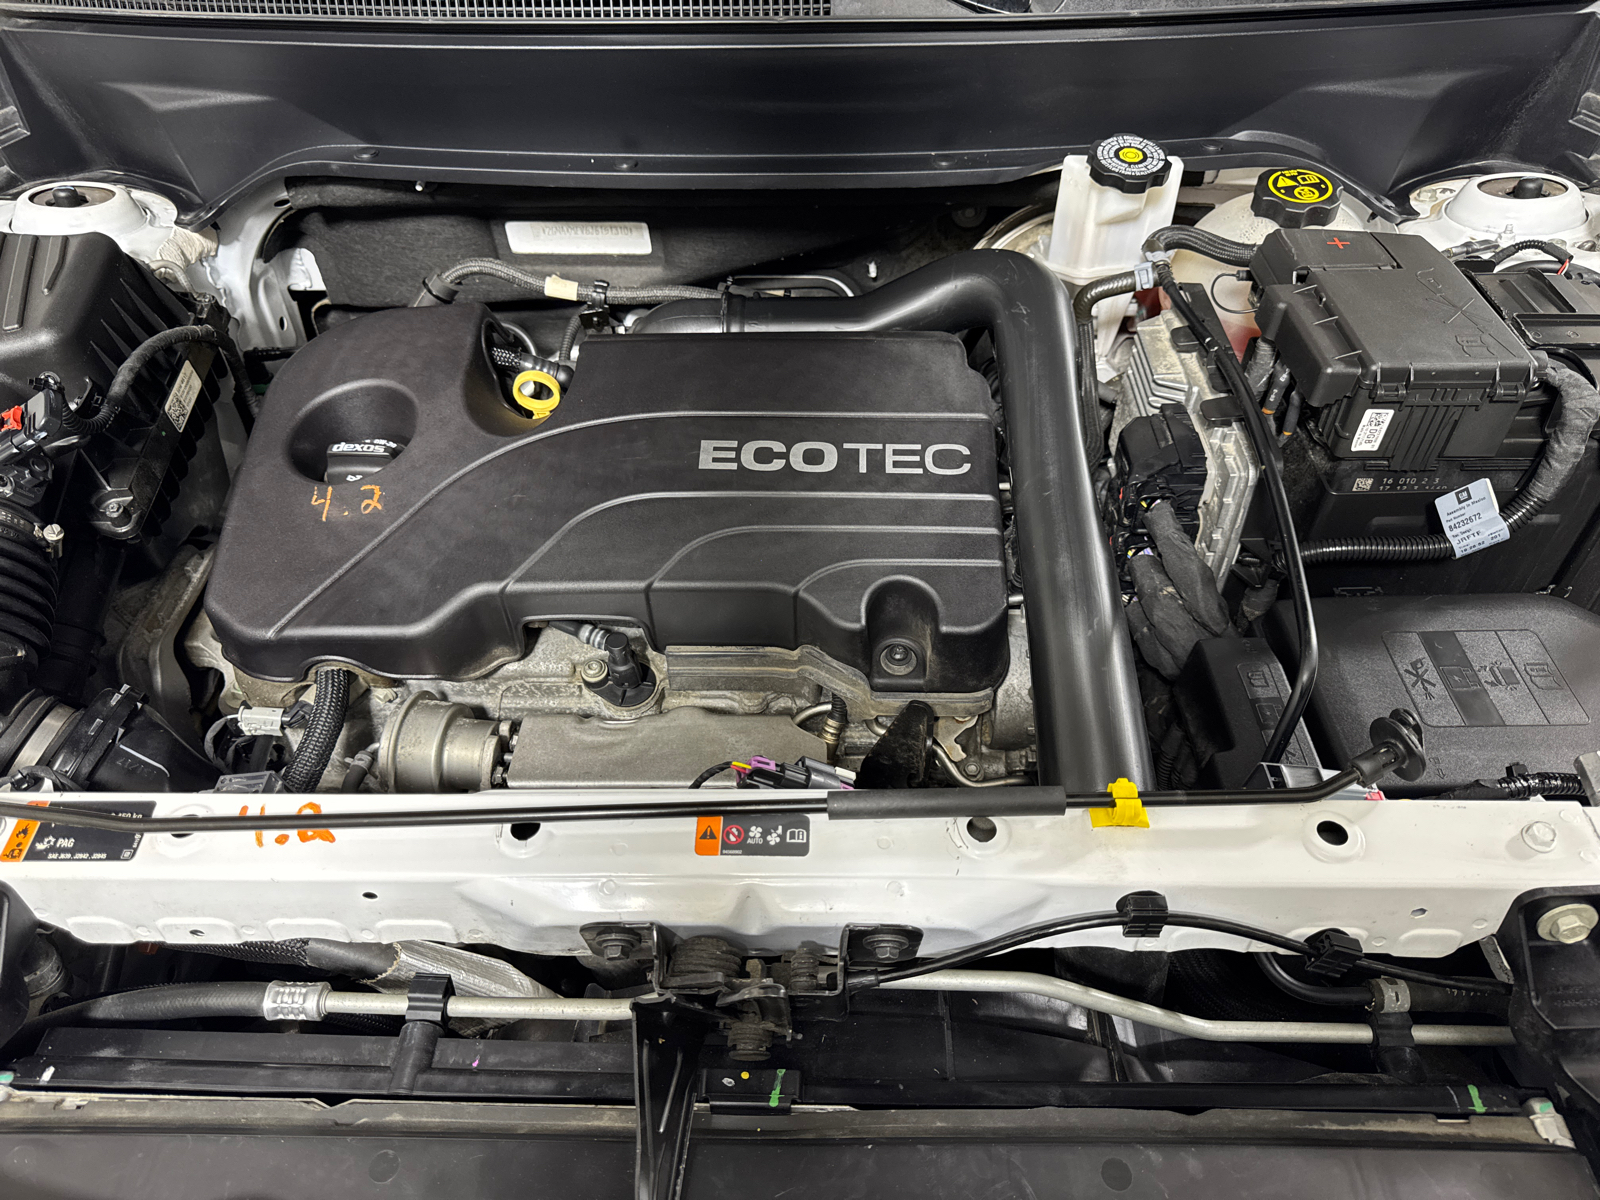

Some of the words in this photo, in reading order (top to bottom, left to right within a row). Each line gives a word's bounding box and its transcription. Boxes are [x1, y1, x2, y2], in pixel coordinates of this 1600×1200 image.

[1364, 428, 1378, 444] DGB
[332, 442, 386, 452] dexos
[698, 440, 972, 475] ECOTEC
[311, 486, 382, 522] 4.2
[1448, 512, 1482, 532] 84232672
[56, 838, 75, 848] PAG
